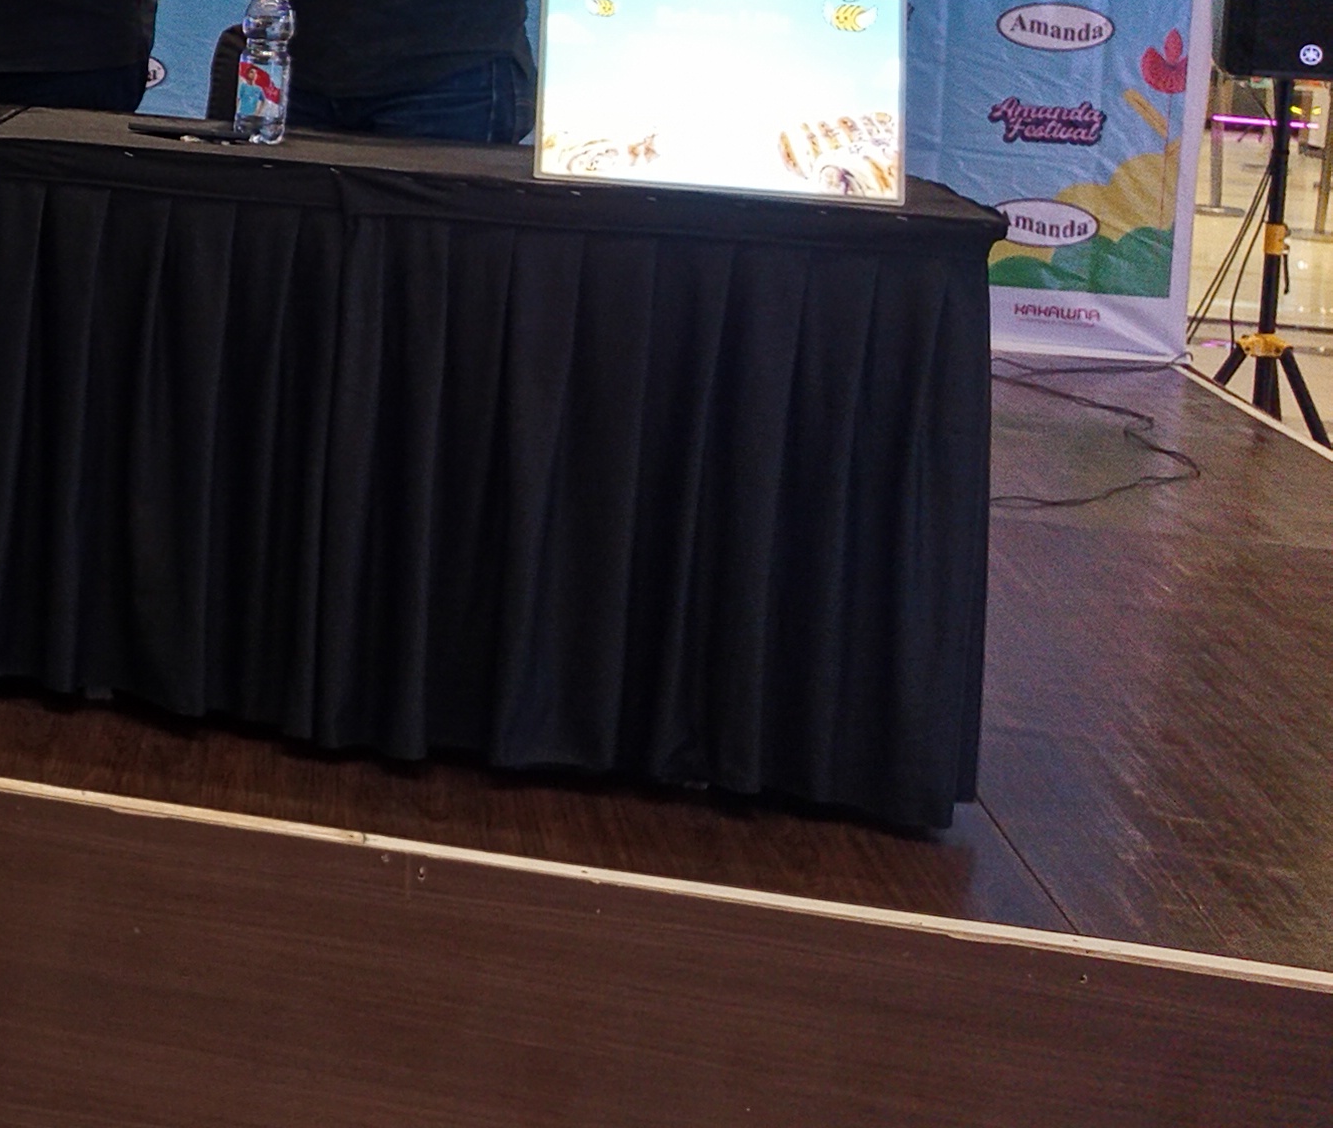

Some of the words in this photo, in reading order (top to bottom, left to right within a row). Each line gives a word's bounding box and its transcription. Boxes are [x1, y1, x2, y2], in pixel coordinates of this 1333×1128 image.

[1009, 13, 1104, 42] Amanda
[992, 97, 1105, 122] Amanda
[1007, 119, 1099, 141] Festival
[1003, 210, 1089, 239] manda
